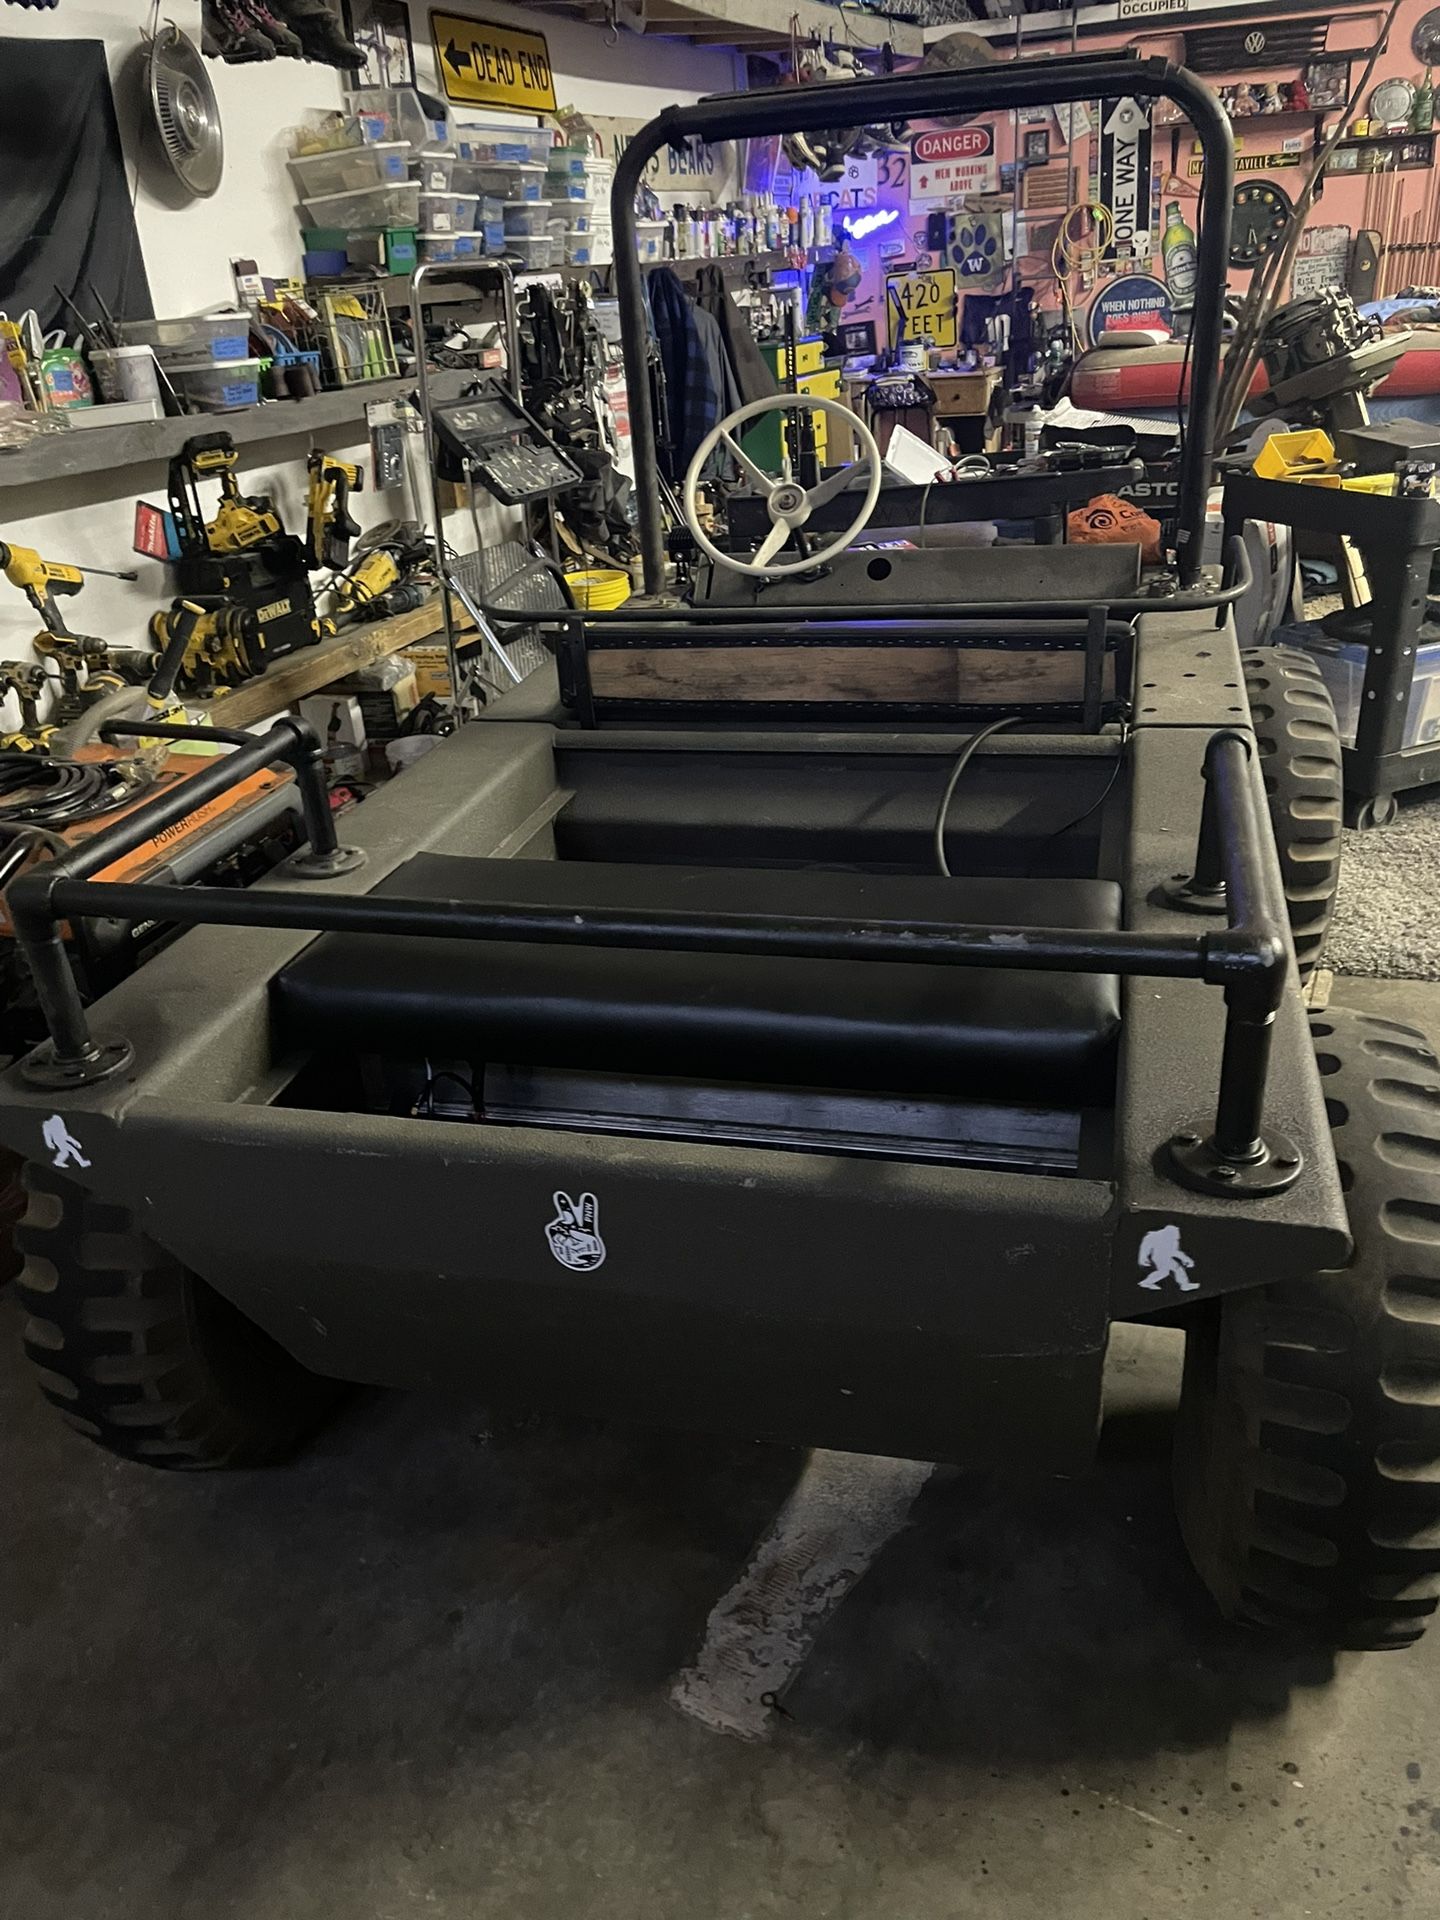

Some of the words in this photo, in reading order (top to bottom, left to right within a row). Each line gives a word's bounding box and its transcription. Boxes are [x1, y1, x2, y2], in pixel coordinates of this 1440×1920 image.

[1122, 0, 1187, 15] OCCUPIED
[471, 41, 515, 86] DEAD
[517, 50, 549, 91] END
[922, 133, 982, 155] DANGER
[934, 167, 951, 180] MEN
[955, 163, 988, 177] WORKING
[1116, 137, 1137, 187] WAY
[949, 179, 973, 192] ABOVE
[1114, 193, 1135, 240] ONE
[967, 257, 984, 273] W
[901, 282, 940, 310] 420
[1101, 299, 1126, 313] WHEN
[1127, 296, 1166, 311] NOTHING
[904, 313, 945, 335] EET
[583, 1202, 594, 1223] PNW
